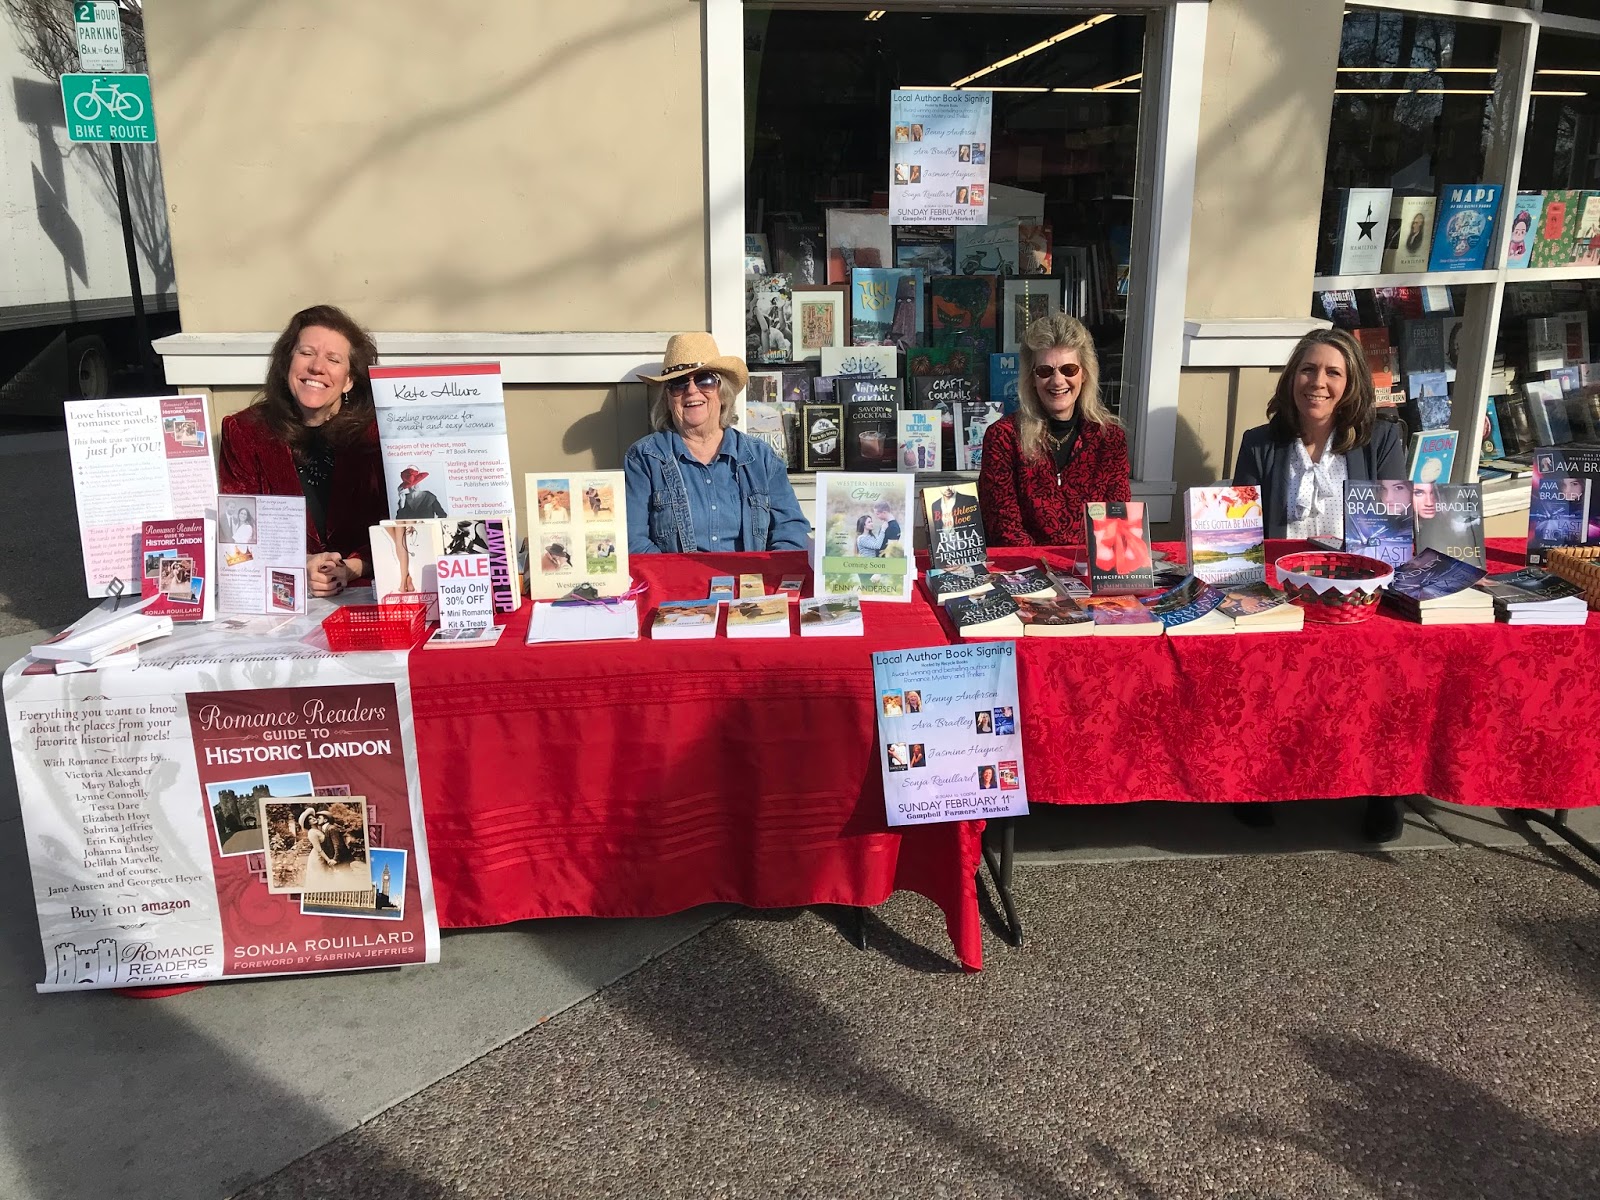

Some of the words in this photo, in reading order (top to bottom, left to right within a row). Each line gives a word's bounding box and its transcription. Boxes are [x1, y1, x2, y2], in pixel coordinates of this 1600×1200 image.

[80, 5, 90, 20] 2
[95, 10, 116, 20] HOUR
[80, 27, 118, 40] PARKING
[894, 94, 912, 102] Local
[915, 94, 941, 102] Author
[943, 94, 962, 102] Book
[965, 94, 990, 104] Signing
[75, 125, 103, 138] BIKE
[110, 125, 148, 138] ROUTE
[931, 147, 957, 157] Bradley
[923, 170, 950, 178] Jasmine
[951, 170, 976, 180] Haynes
[1451, 189, 1495, 203] MAPS
[857, 280, 889, 295] TIKI
[861, 294, 892, 311] POP
[1414, 328, 1438, 337] FRENCH
[854, 382, 890, 392] VINTAGE
[933, 378, 965, 390] CRAFT
[393, 383, 428, 401] Kate
[431, 382, 481, 398] Allure
[852, 394, 894, 402] COCKTAILS
[928, 391, 971, 400] COCKTAILS
[97, 408, 143, 418] historical
[124, 415, 157, 424] novels?
[386, 412, 419, 422] Sizzling
[461, 411, 474, 422] for
[397, 422, 424, 431] smart
[426, 421, 443, 429] and
[445, 424, 463, 432] sexy
[1423, 437, 1455, 453] LEON
[851, 488, 881, 501] Grey
[1348, 488, 1375, 500] AVA
[1457, 490, 1478, 498] AVA
[1540, 492, 1583, 501] BRADLEY
[1348, 502, 1411, 516] BRADLEY
[1435, 502, 1478, 512] BRADLEY
[145, 524, 175, 534] Romance
[176, 523, 202, 532] Readers
[1195, 520, 1210, 529] SHE'S
[1212, 520, 1232, 529] GOTTA
[1233, 520, 1241, 529] BE
[1243, 518, 1259, 528] MINE
[939, 529, 979, 543] BELLA
[936, 537, 985, 554] ANDRE
[1446, 547, 1481, 558] EDGE
[438, 558, 489, 578] SALE
[1197, 572, 1233, 582] JENNIFER
[1236, 570, 1263, 582] SKULLY
[440, 585, 467, 595] Today
[469, 584, 489, 593] Only
[832, 584, 855, 592] JENNY
[446, 596, 465, 606] 30%
[466, 595, 484, 605] OFF
[876, 655, 902, 666] Local
[906, 651, 942, 662] Author
[946, 649, 973, 659] Book
[976, 646, 1012, 657] Signing
[924, 694, 952, 705] Jenny
[955, 691, 998, 701] Andersen
[19, 708, 79, 722] Everything
[82, 709, 101, 718] you
[105, 707, 133, 716] want
[136, 705, 146, 714] to
[149, 702, 178, 714] know
[199, 704, 299, 732] Romance
[303, 697, 387, 725] Readers
[29, 725, 61, 734] about
[64, 722, 80, 732] the
[83, 720, 115, 734] places
[118, 719, 143, 732] from
[147, 720, 171, 729] your
[912, 720, 932, 731] Ava
[935, 717, 973, 729] Bradley
[35, 735, 77, 750] favorite
[81, 732, 130, 744] historical
[134, 730, 170, 742] novels!
[263, 729, 307, 741] GUIDE
[311, 728, 330, 739] TO
[204, 745, 303, 766] HISTORIC
[306, 739, 392, 760] LONDON
[928, 748, 965, 759] Jasmine
[967, 745, 1004, 757] Haynes
[65, 770, 103, 780] Victoria
[105, 767, 153, 777] Alexander
[82, 780, 106, 791] Mary
[109, 779, 140, 790] Balogh
[902, 778, 928, 790] Sonja
[931, 772, 976, 786] Rouillard
[76, 792, 105, 803] Lynne
[107, 789, 149, 800] Connolly
[90, 804, 115, 812] Tessa
[117, 802, 140, 810] Dare
[906, 811, 941, 819] Campbell
[945, 808, 978, 816] Farmers'
[82, 813, 124, 824] Elizabeth
[127, 813, 150, 822] Hoyt
[83, 825, 119, 834] Sabrina
[121, 823, 153, 833] Jeffries
[86, 837, 107, 846] Erin
[109, 834, 153, 846] Knightley
[83, 848, 122, 857] Johanna
[124, 844, 159, 855] Lindsey
[84, 858, 118, 869] Delilah
[120, 855, 163, 865] Marvelle,
[48, 886, 69, 897] Jane
[72, 882, 105, 892] Austen
[107, 879, 124, 888] and
[127, 877, 173, 887] Georgette
[175, 874, 203, 884] Heyer
[70, 905, 100, 922] Buy
[102, 904, 113, 917] it
[117, 905, 137, 915] on
[141, 899, 191, 914] amazon
[233, 941, 298, 959] SONJA
[305, 931, 415, 952] ROUILLARD
[121, 941, 214, 963] ROMANCE
[233, 957, 293, 970] FOREWORD
[297, 955, 311, 964] BY
[314, 951, 361, 963] SABRINA
[364, 946, 415, 957] JEFFRIES
[129, 958, 208, 975] READERS
